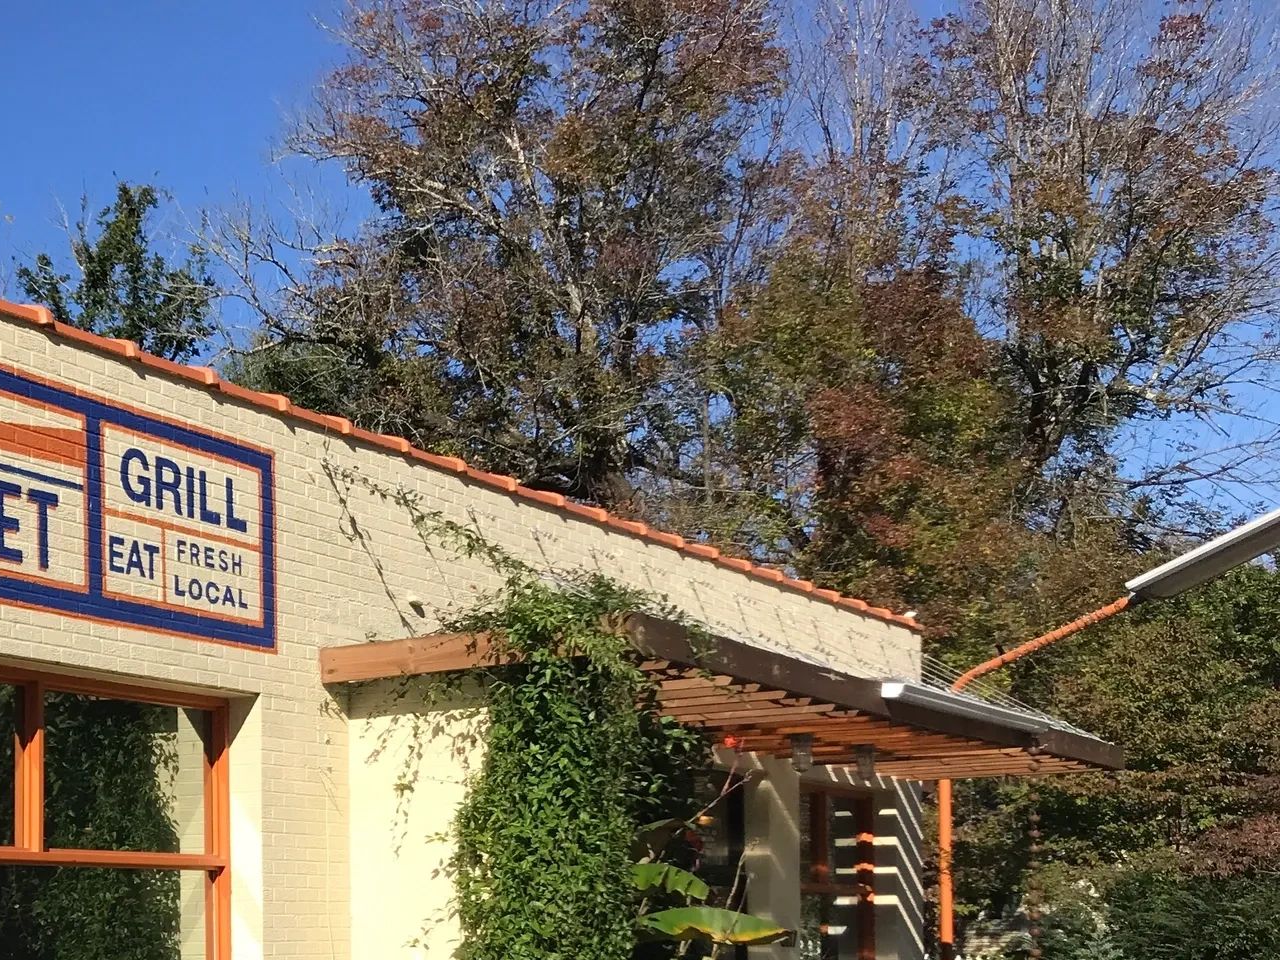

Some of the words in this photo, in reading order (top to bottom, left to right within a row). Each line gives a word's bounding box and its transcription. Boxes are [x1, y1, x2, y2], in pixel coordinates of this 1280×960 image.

[120, 448, 248, 534] GRILL
[109, 536, 160, 580] EAT
[177, 540, 242, 575] FRESH
[174, 575, 249, 609] LOCAL
